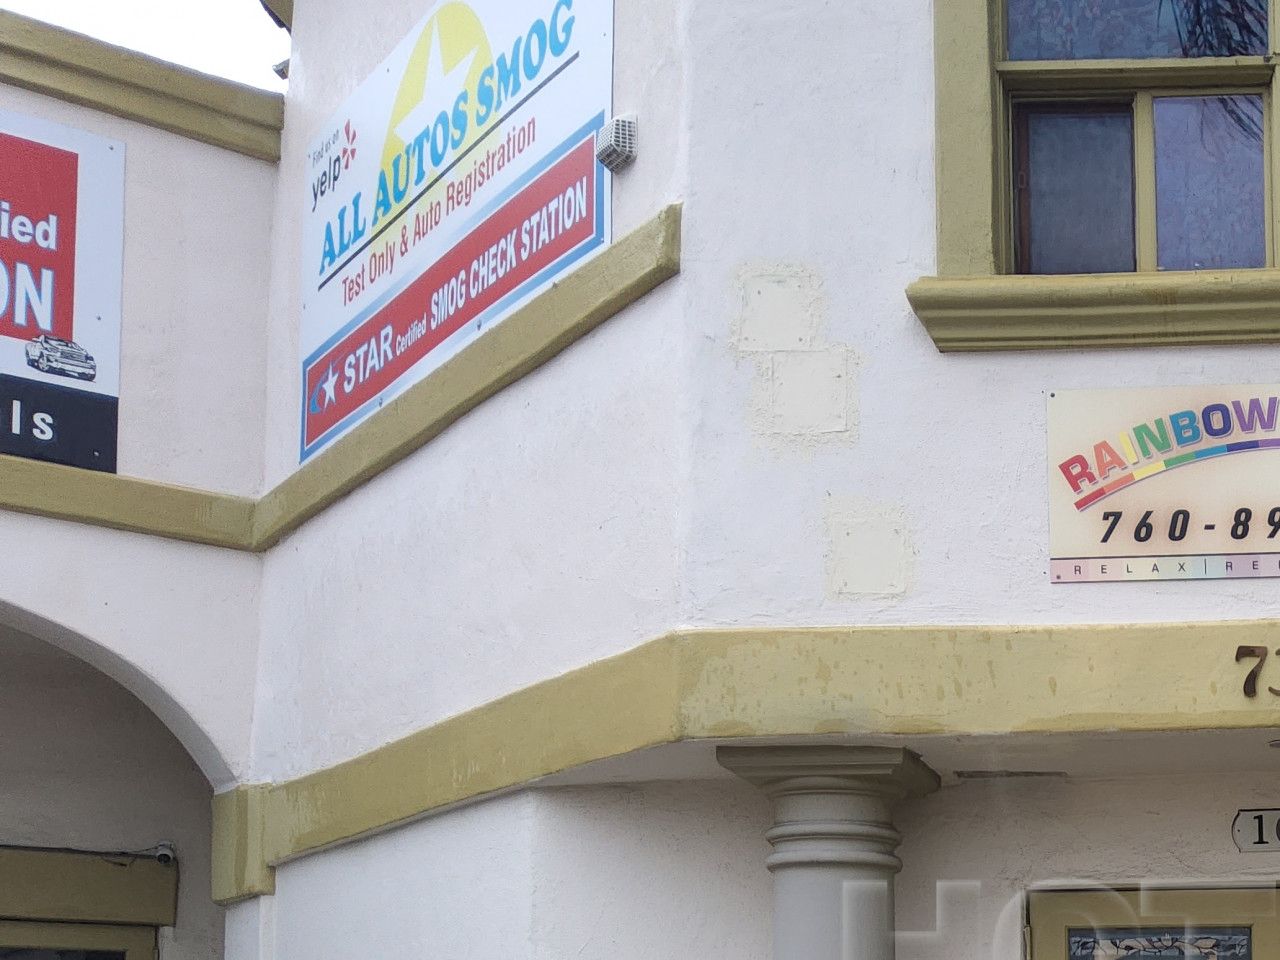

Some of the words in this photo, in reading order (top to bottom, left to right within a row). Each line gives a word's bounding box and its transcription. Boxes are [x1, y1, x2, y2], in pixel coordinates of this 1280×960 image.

[311, 154, 341, 213] yelp
[319, 192, 366, 276] ALL
[372, 89, 468, 227] AUTOS
[476, 0, 576, 127] SMOG
[342, 269, 365, 307] Test
[369, 240, 396, 285] Only
[400, 226, 409, 257] &
[413, 201, 441, 246] Auto
[446, 117, 536, 217] Registration
[0, 258, 54, 333] N
[343, 324, 394, 394] STAR
[396, 313, 427, 356] Certified
[431, 270, 466, 330] SMOG
[469, 229, 517, 299] CHECK
[521, 177, 587, 261] STATION
[1058, 396, 1280, 494] RAINBOW
[1074, 562, 1186, 575] RELAX
